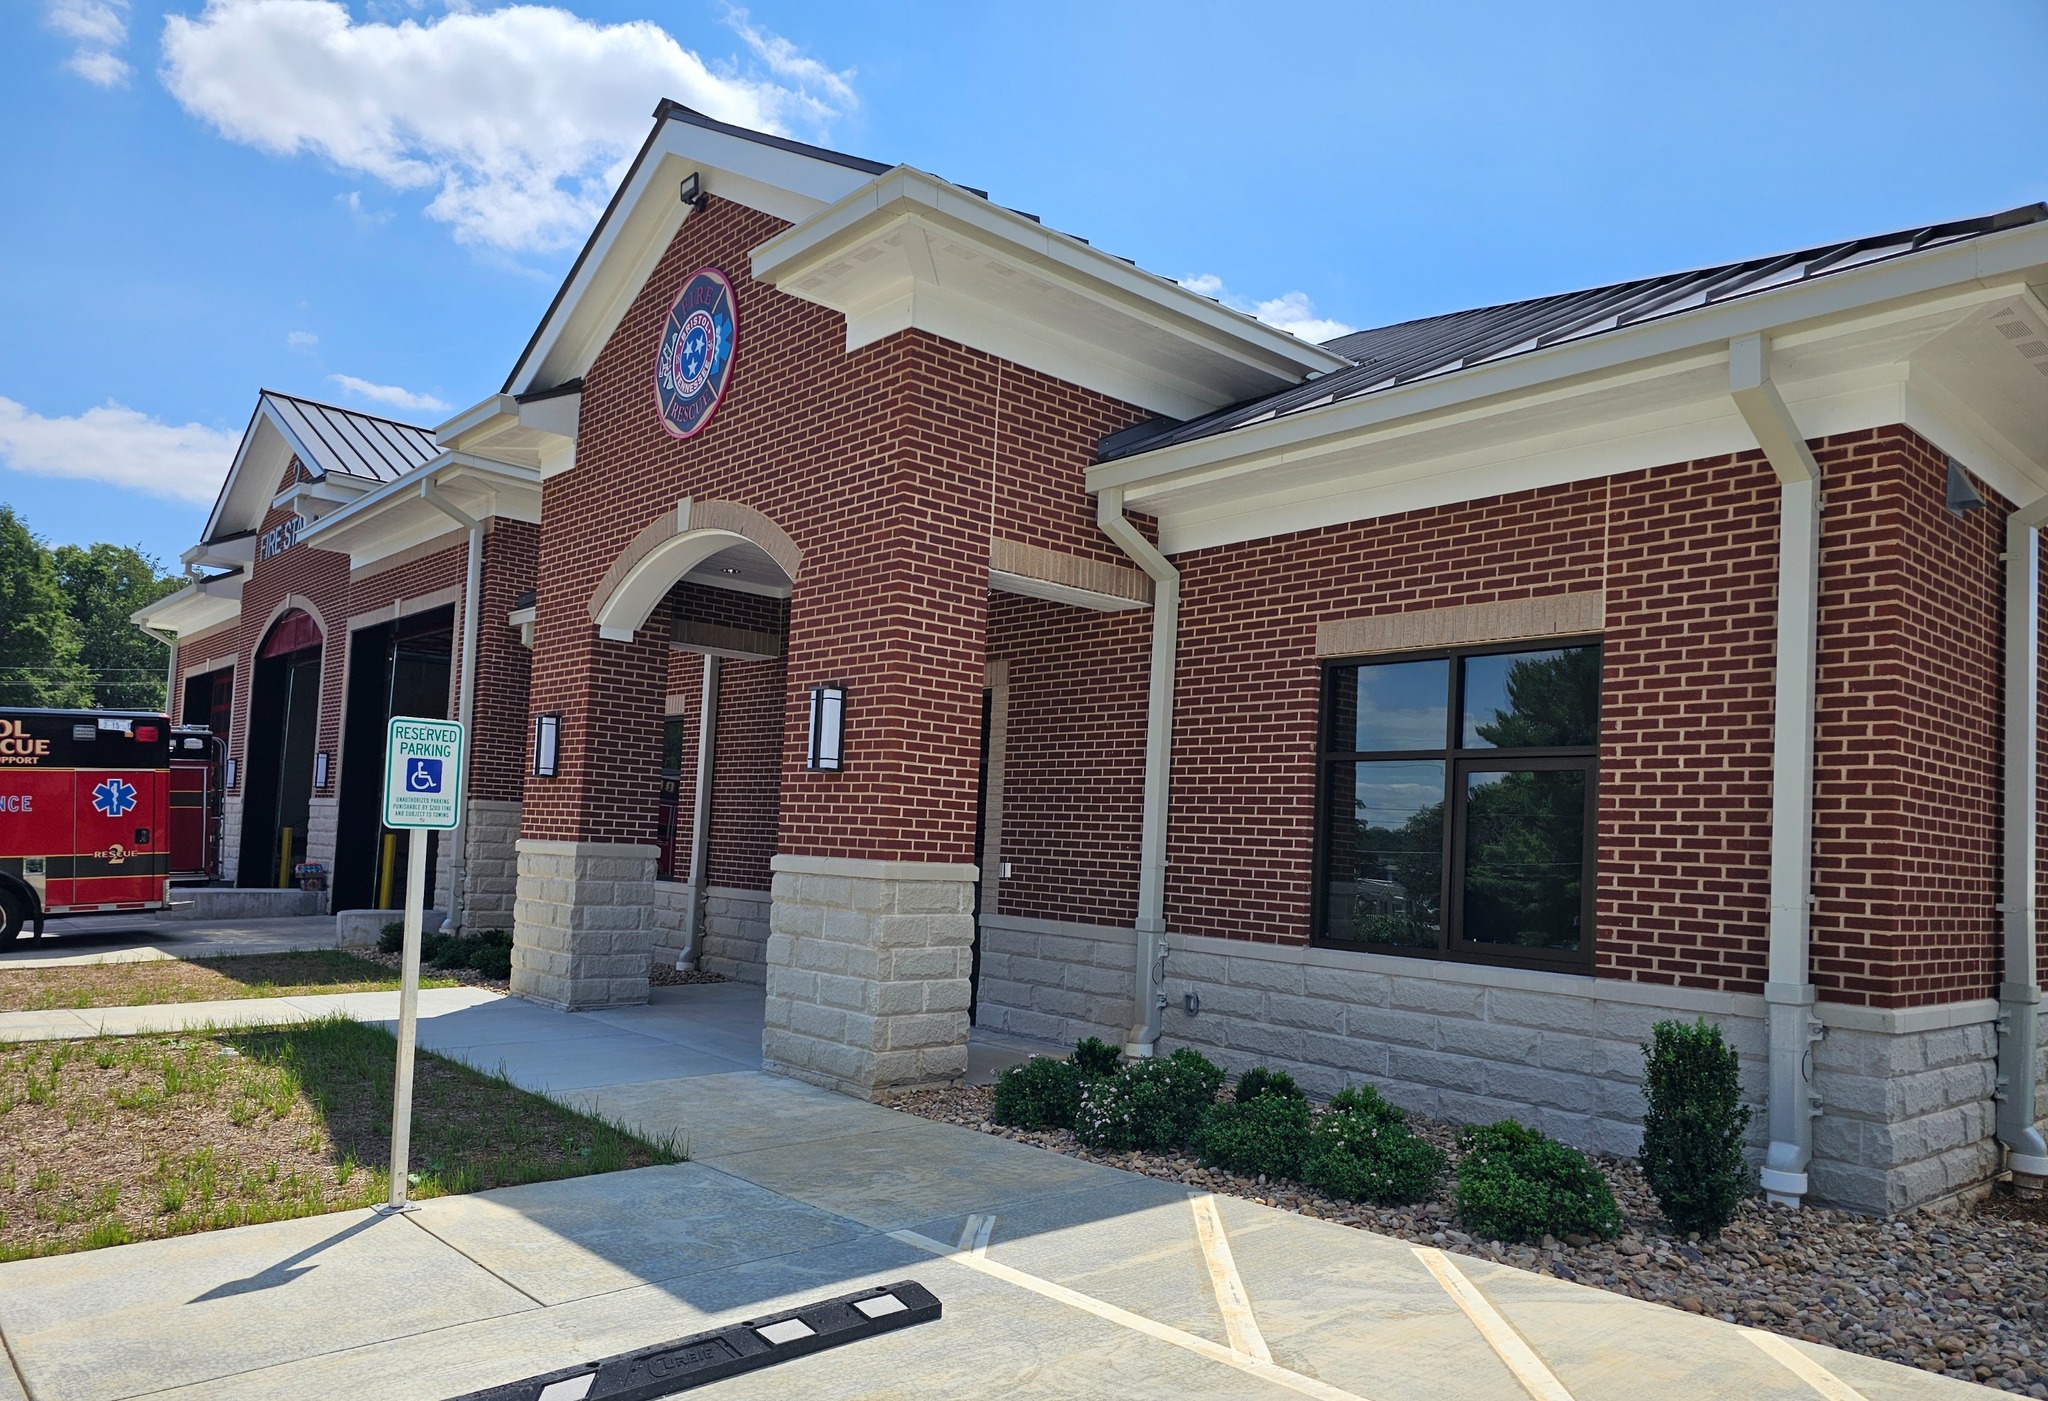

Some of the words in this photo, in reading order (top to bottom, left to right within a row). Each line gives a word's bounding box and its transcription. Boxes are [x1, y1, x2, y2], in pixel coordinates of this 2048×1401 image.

[681, 285, 714, 316] FIRE
[681, 314, 711, 339] BRISTOL
[675, 360, 711, 394] TENNESSEE
[670, 388, 711, 423] RESCUE
[260, 526, 282, 562] FIRE
[395, 726, 457, 743] RESERVED
[0, 756, 40, 764] PPORT
[400, 742, 451, 758] PARKING
[94, 850, 138, 858] RESCUE
